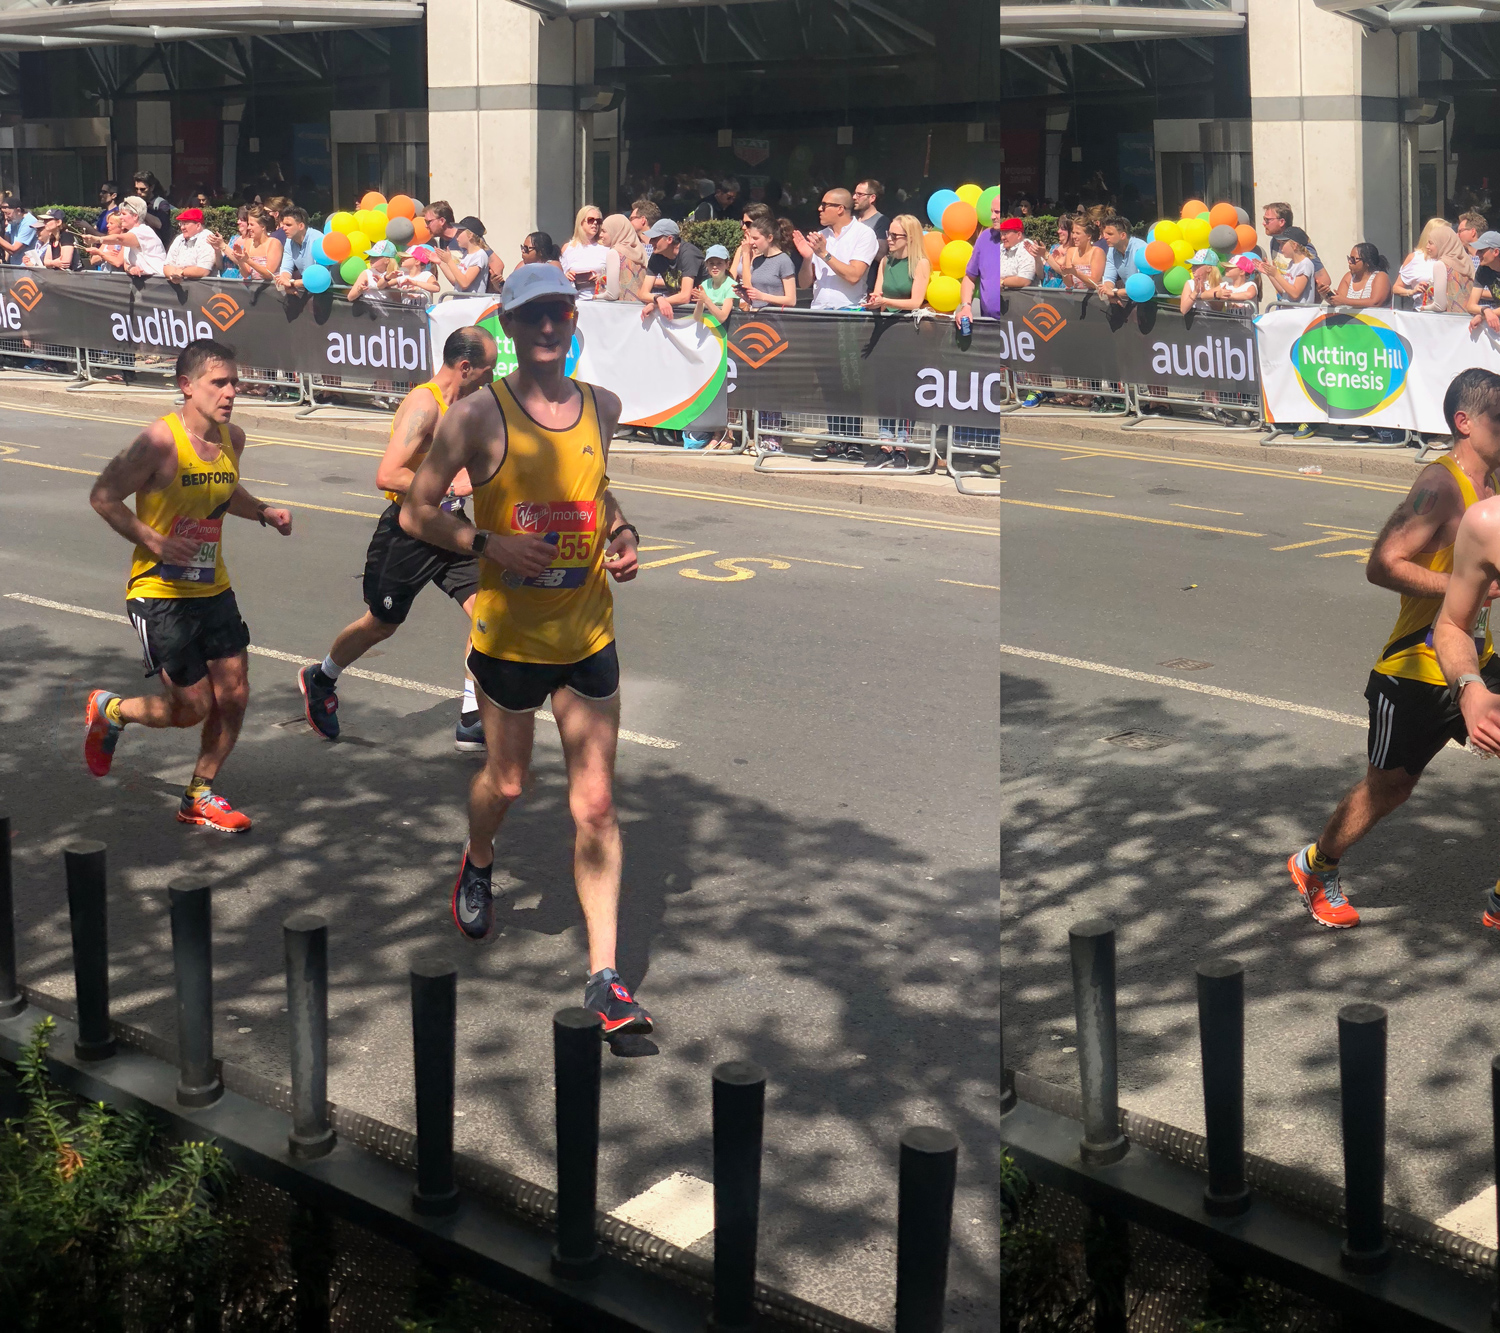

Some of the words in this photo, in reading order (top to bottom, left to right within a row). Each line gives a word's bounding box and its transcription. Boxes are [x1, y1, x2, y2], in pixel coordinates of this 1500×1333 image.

[326, 325, 427, 371] audibl
[1151, 335, 1254, 382] audibl
[1374, 348, 1404, 369] Hill
[181, 472, 235, 487] BEDFORD
[519, 504, 550, 530] Virgin
[552, 510, 593, 523] money
[200, 526, 220, 535] money
